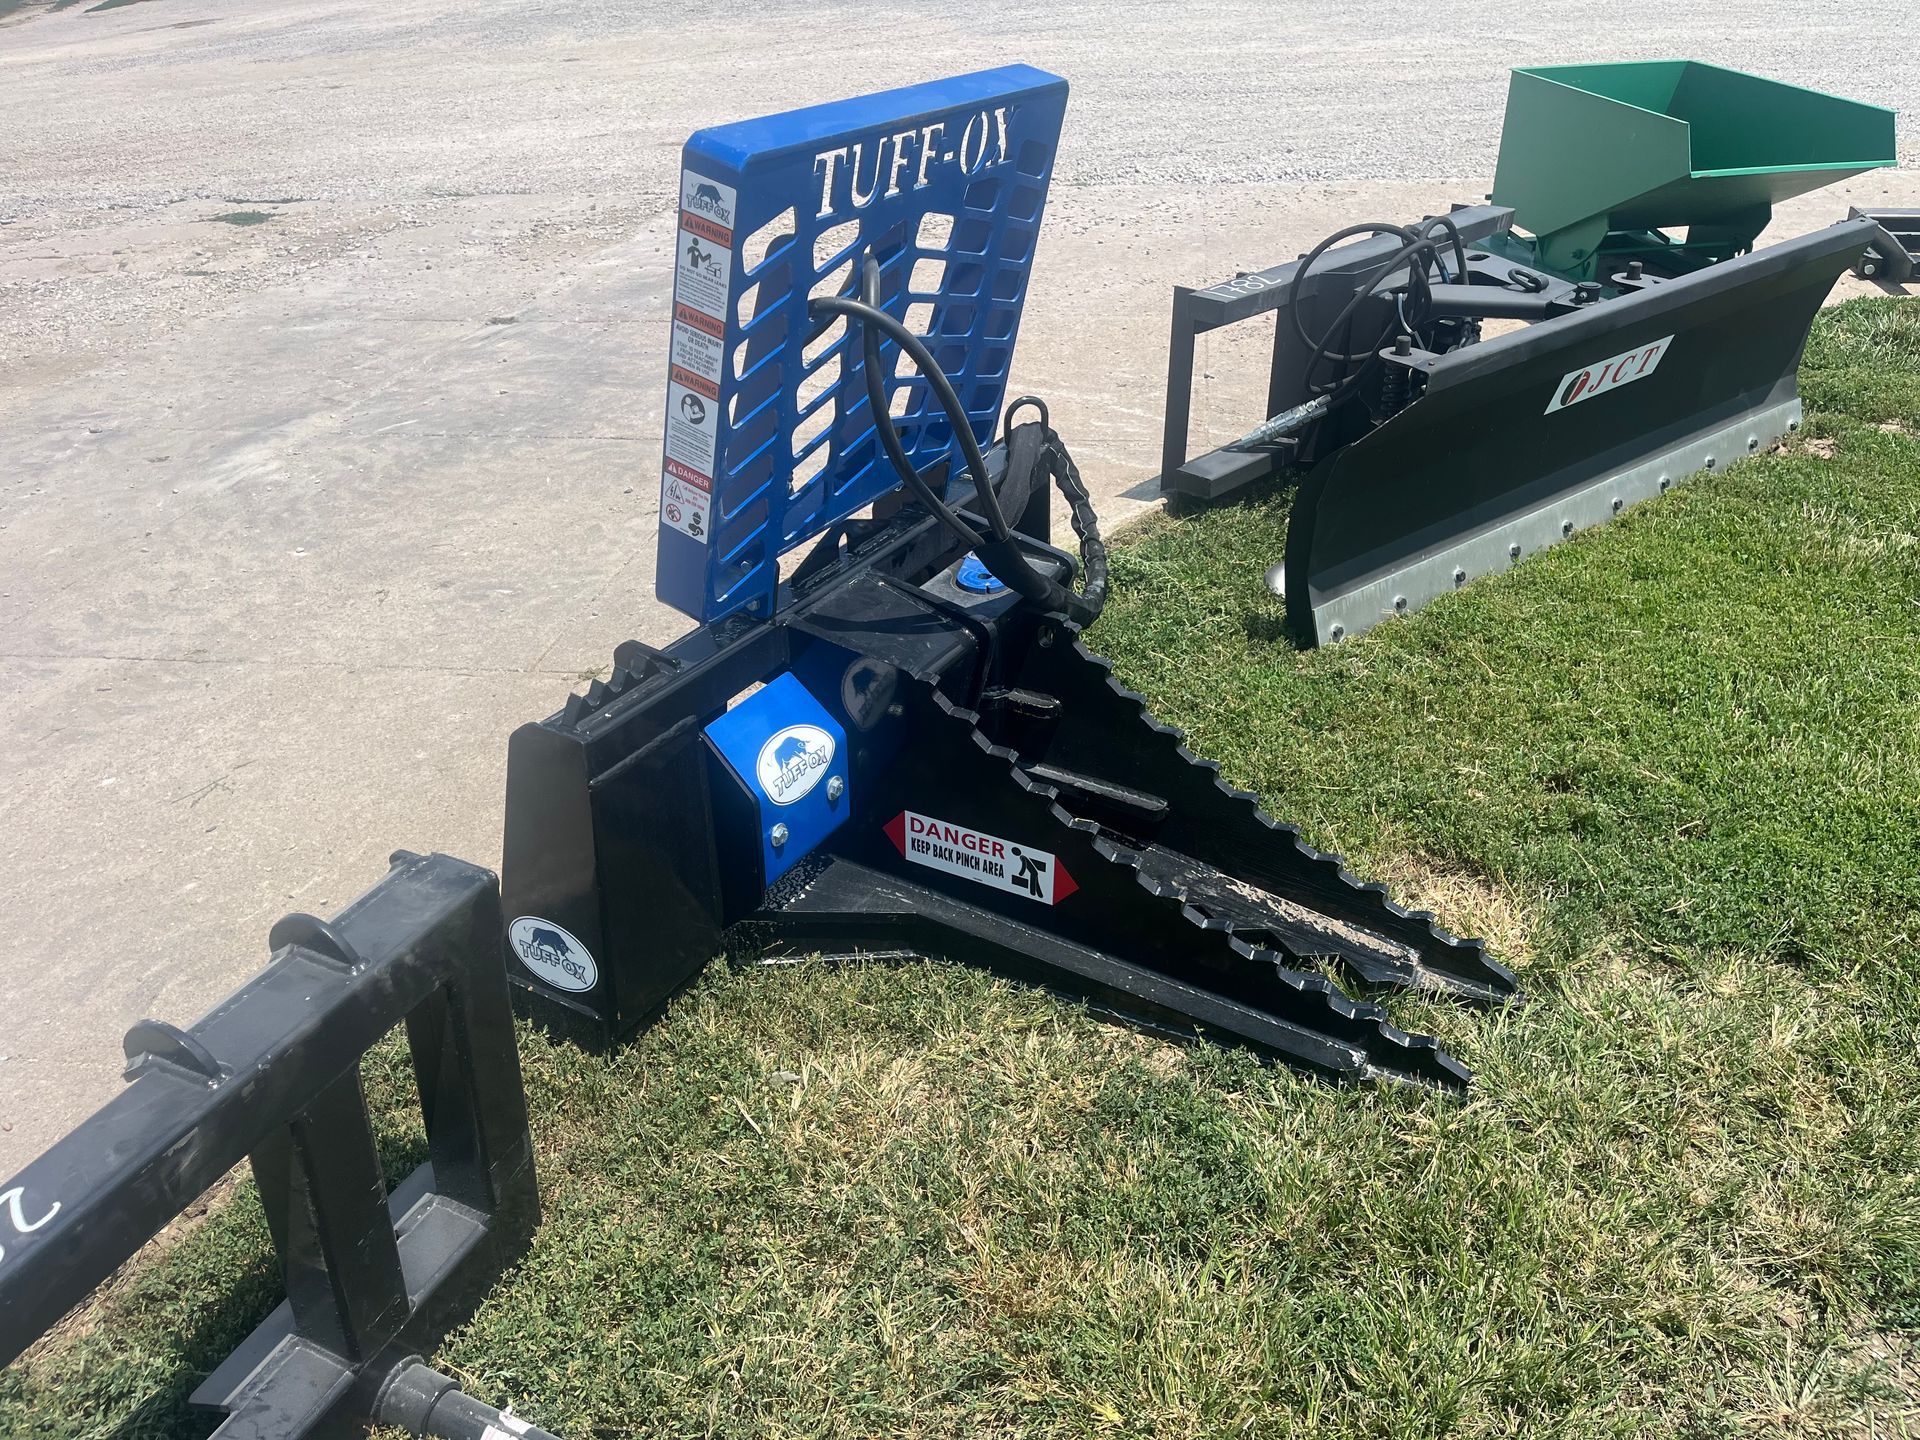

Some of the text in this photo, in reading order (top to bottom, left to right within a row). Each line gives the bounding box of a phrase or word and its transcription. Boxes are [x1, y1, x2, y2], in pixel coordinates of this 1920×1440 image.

[813, 104, 1020, 220] TUFF-OX
[687, 194, 731, 225] TUFF OX
[694, 220, 729, 243] WARNING
[1203, 274, 1282, 299] 1782
[688, 311, 722, 334] WARNING
[684, 374, 717, 396] WARNING
[1588, 345, 1661, 393] JCT
[678, 468, 709, 488] DANGER
[773, 745, 828, 797] TUFF OX
[910, 816, 1005, 859] DANGER
[911, 837, 1004, 879] KEEP BACK PINCH AREA
[519, 939, 588, 985] TUFF OX
